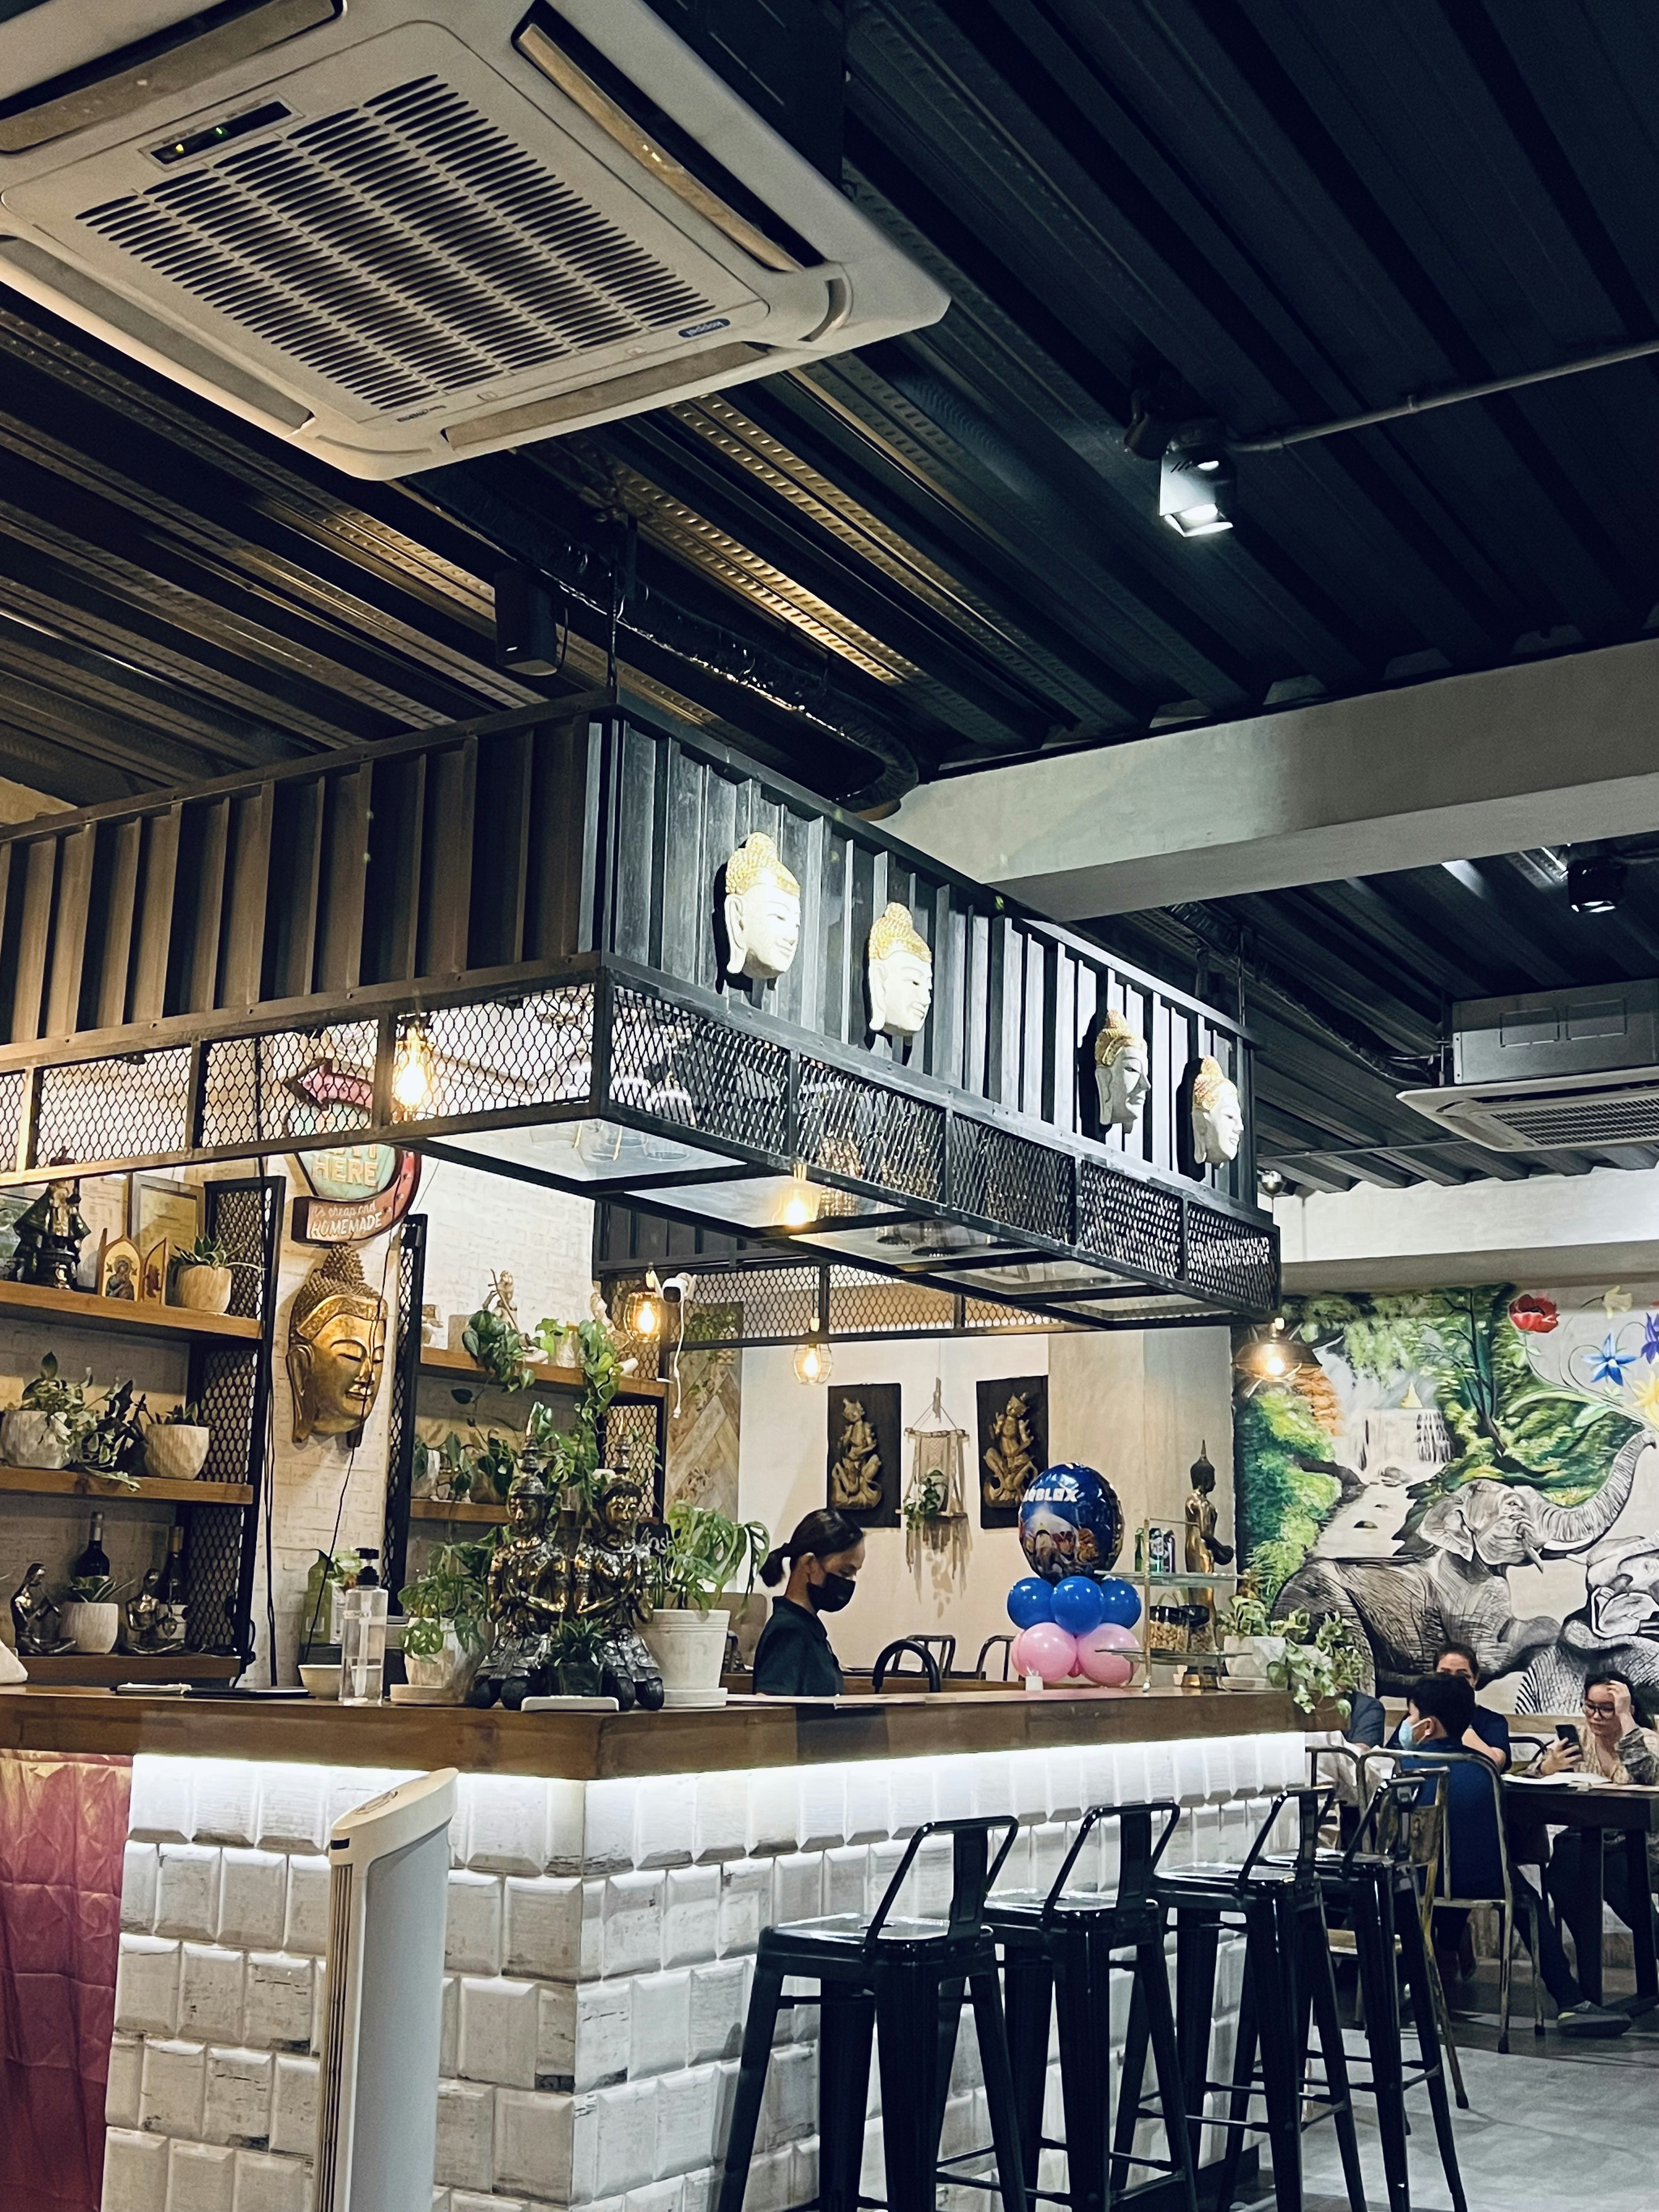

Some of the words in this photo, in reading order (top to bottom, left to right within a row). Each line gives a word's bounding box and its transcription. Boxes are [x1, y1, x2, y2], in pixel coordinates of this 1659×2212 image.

[312, 1154, 378, 1186] HERE
[357, 1200, 376, 1215] and
[311, 1211, 382, 1237] HOMEMADE
